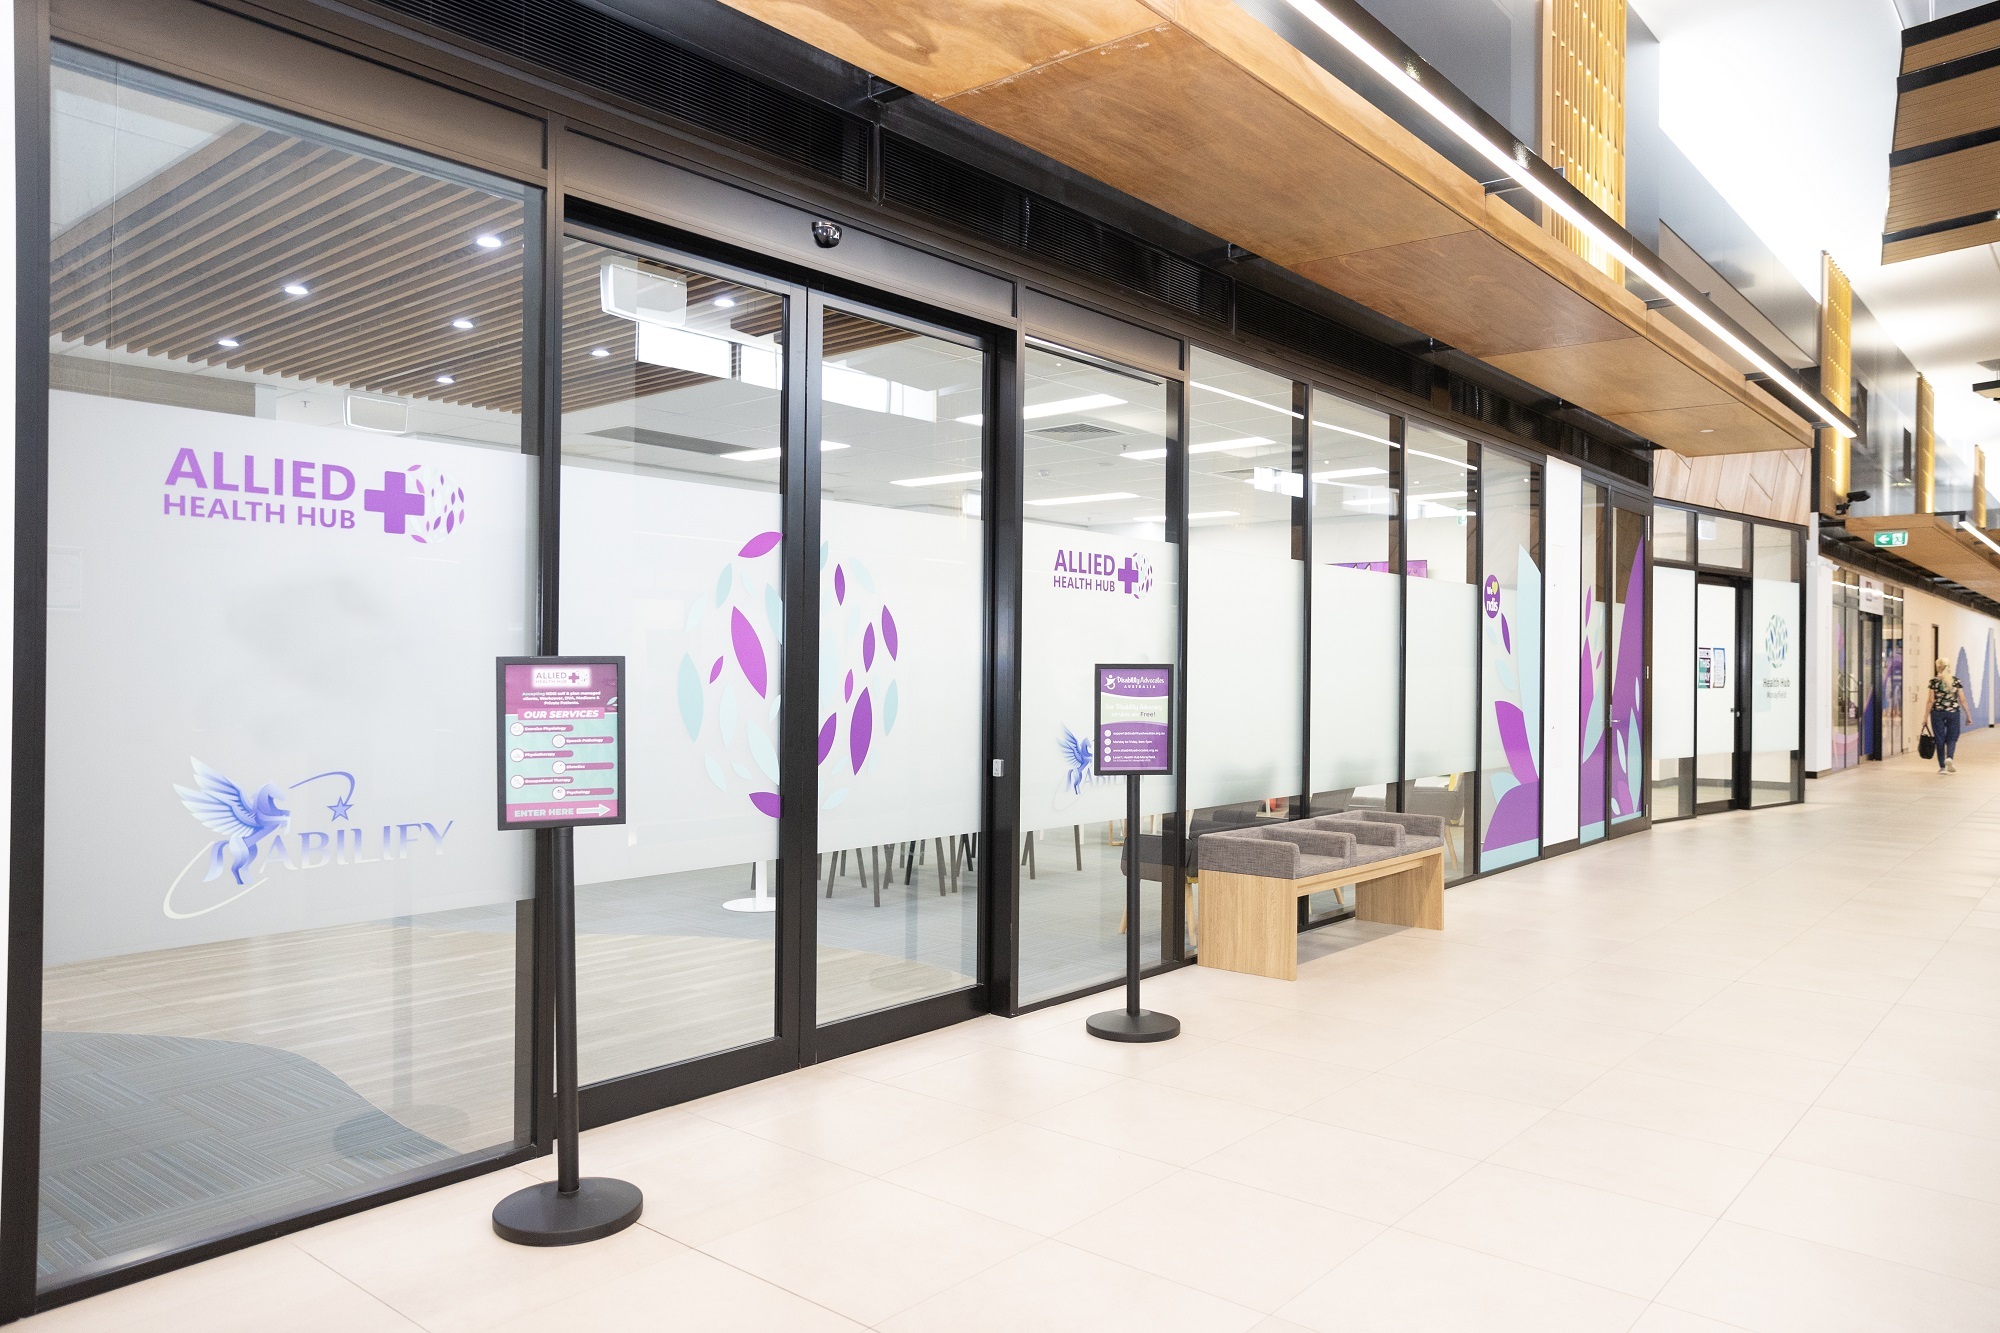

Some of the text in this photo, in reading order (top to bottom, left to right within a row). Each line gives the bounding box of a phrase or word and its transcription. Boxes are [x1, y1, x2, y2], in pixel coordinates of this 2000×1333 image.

[164, 447, 356, 502] ALLIED
[163, 493, 356, 529] HEALTH HUB
[1054, 549, 1115, 576] ALLIED
[1053, 575, 1115, 592] HEALTH HUB
[1116, 676, 1165, 684] Disability Advocates
[523, 709, 600, 719] OUR SERVICES
[514, 808, 575, 818] ENTER HERE
[259, 820, 454, 874] ABILIFY
